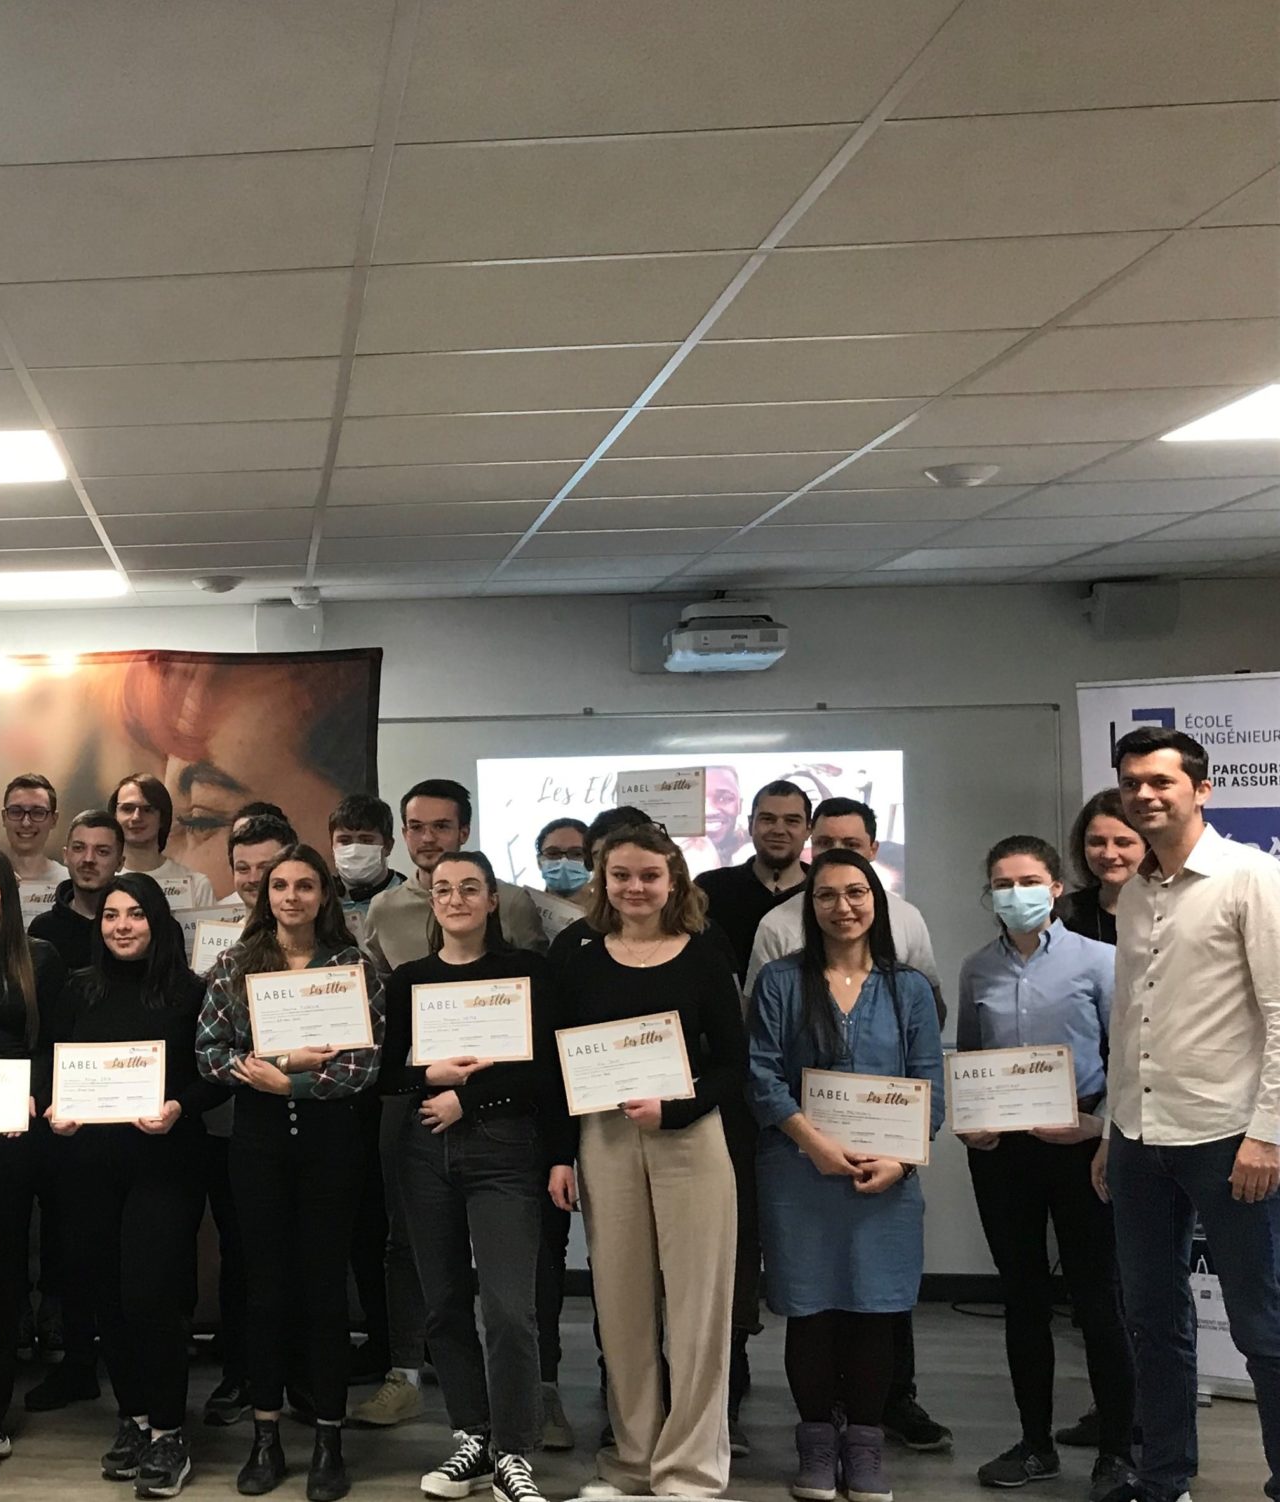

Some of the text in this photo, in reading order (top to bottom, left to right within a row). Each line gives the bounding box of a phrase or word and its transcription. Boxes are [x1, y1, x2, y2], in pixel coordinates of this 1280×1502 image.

[1185, 713, 1233, 729] ÉCOLE
[1212, 763, 1280, 775] PARCOUR
[537, 774, 617, 805] Les Ell
[622, 785, 649, 794] LABEL
[1232, 777, 1280, 787] ASSUR
[256, 980, 347, 1001] LABEL Les Elles
[420, 992, 511, 1011] LABEL Les Elles
[567, 1030, 663, 1057] LABEL Les Elles
[61, 1055, 147, 1070] LABEL Les Elles
[954, 1061, 1054, 1080] LABEL Les Elles
[808, 1088, 910, 1106] LABEL Les Elles
